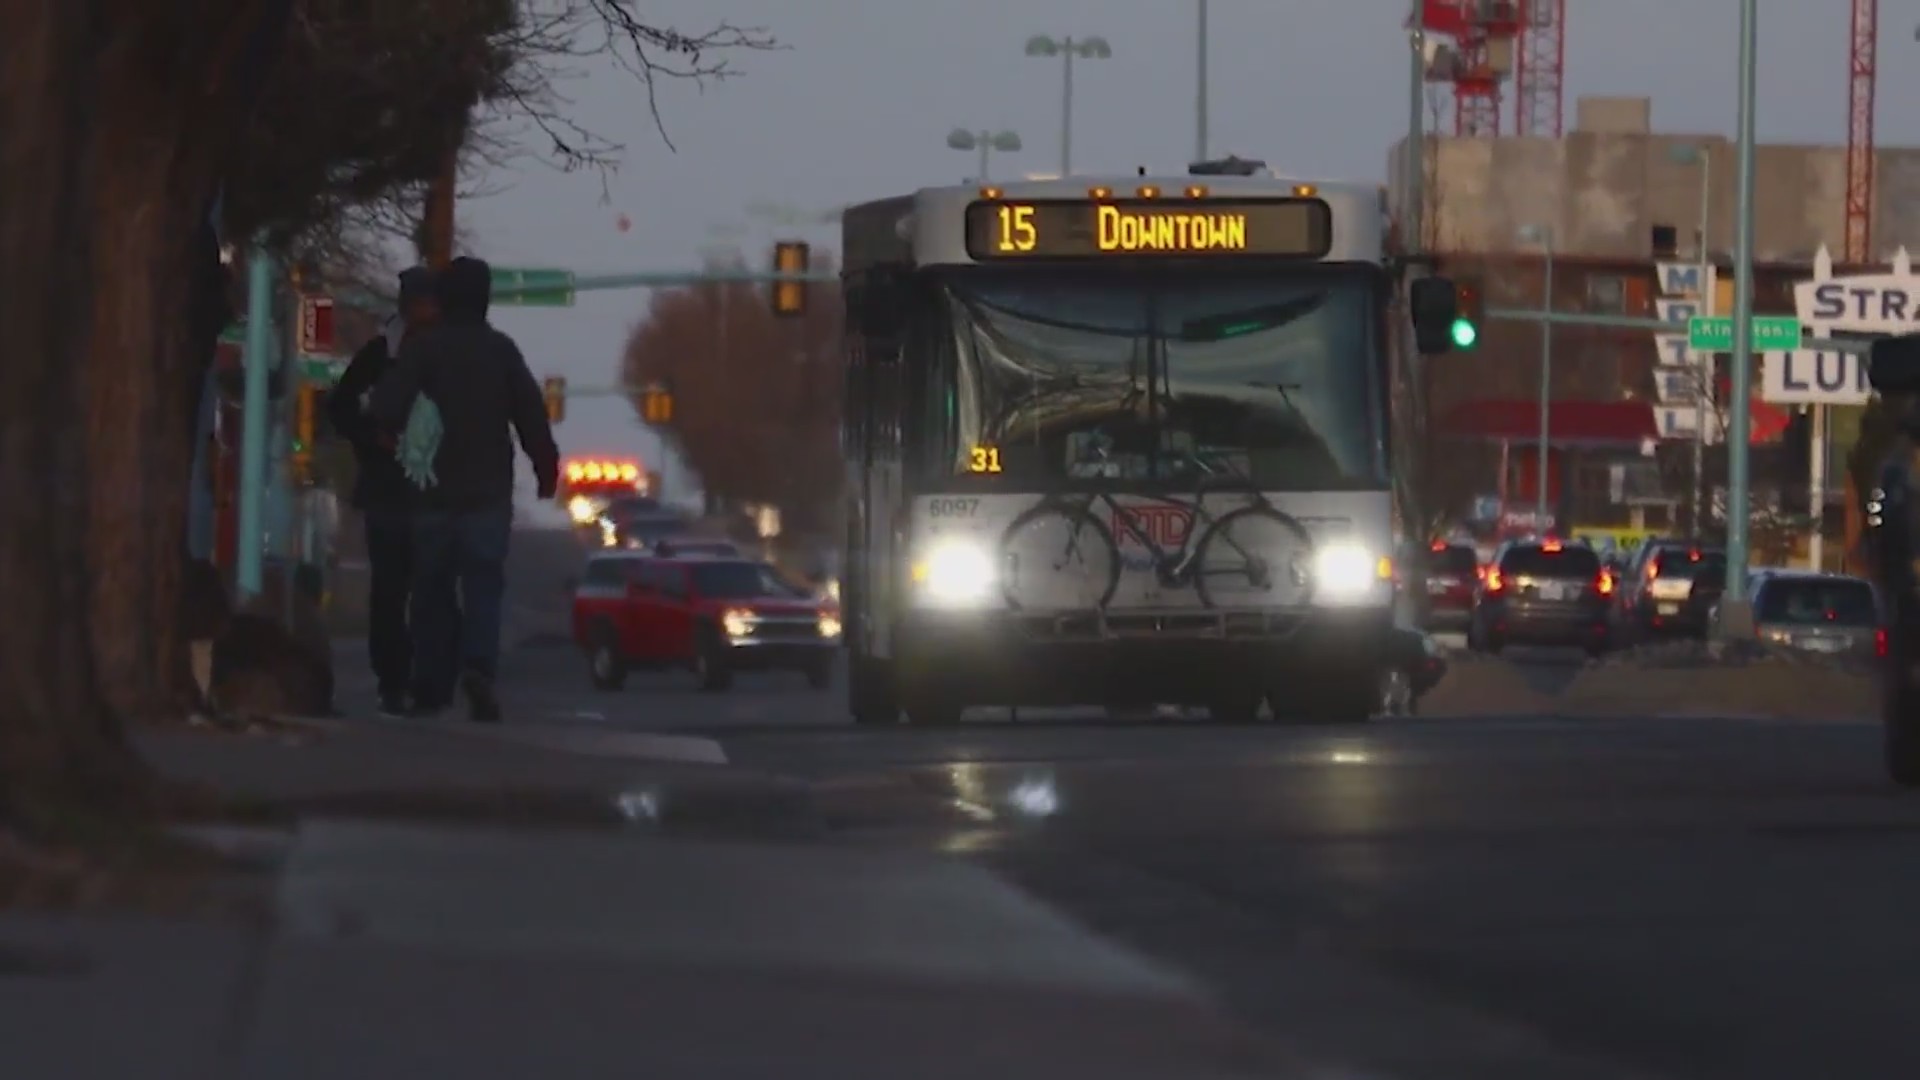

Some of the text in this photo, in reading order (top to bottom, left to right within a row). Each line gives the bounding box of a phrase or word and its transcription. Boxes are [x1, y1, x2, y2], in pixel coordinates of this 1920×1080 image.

[999, 206, 1036, 250] 15
[1813, 284, 1920, 320] STR
[970, 447, 1001, 472] 31
[929, 499, 979, 518] 6097
